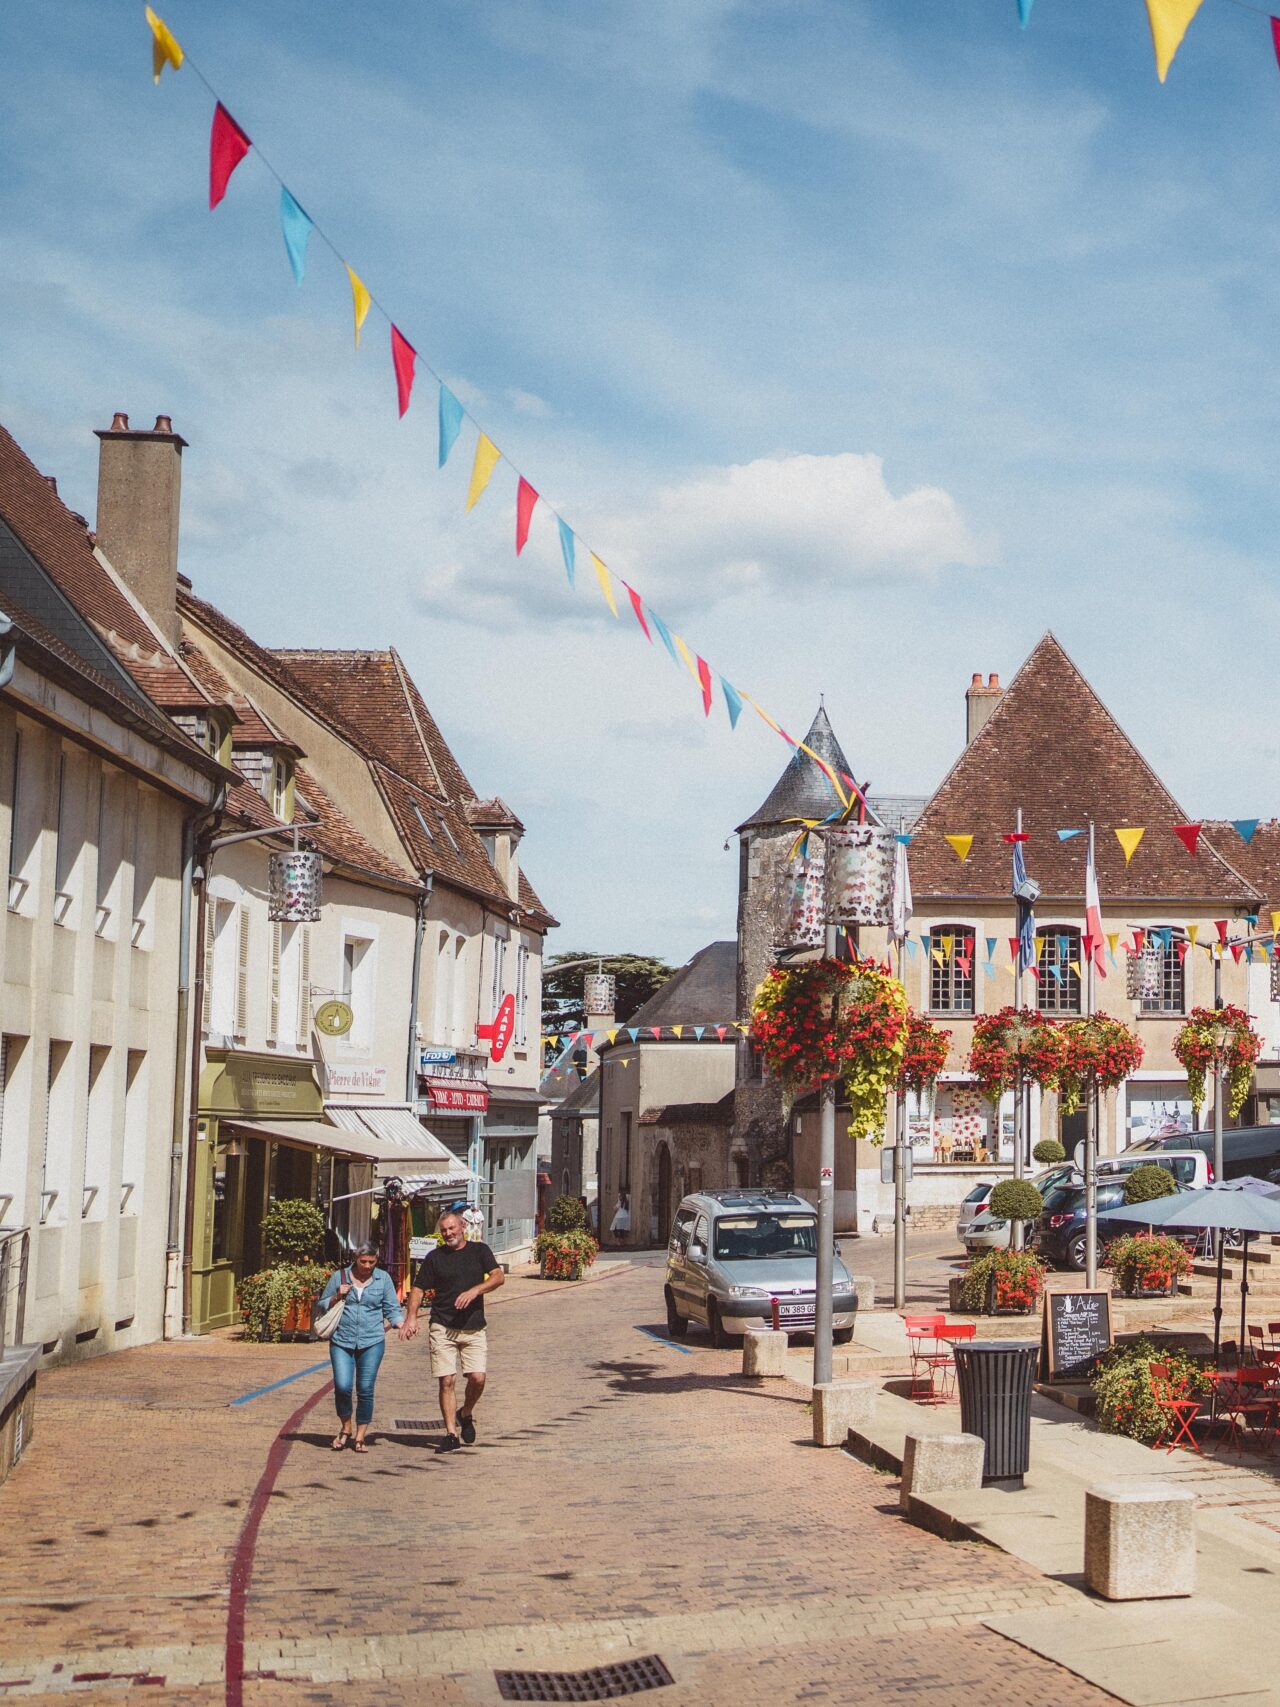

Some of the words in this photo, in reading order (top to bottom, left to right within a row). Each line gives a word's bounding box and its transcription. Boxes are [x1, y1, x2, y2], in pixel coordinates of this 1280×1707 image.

[495, 1007, 510, 1049] TABAC
[426, 1052, 442, 1060] FDJ
[328, 1069, 352, 1086] Pierre
[351, 1071, 361, 1086] de
[361, 1071, 382, 1088] Vigne
[781, 1306, 790, 1314] DN
